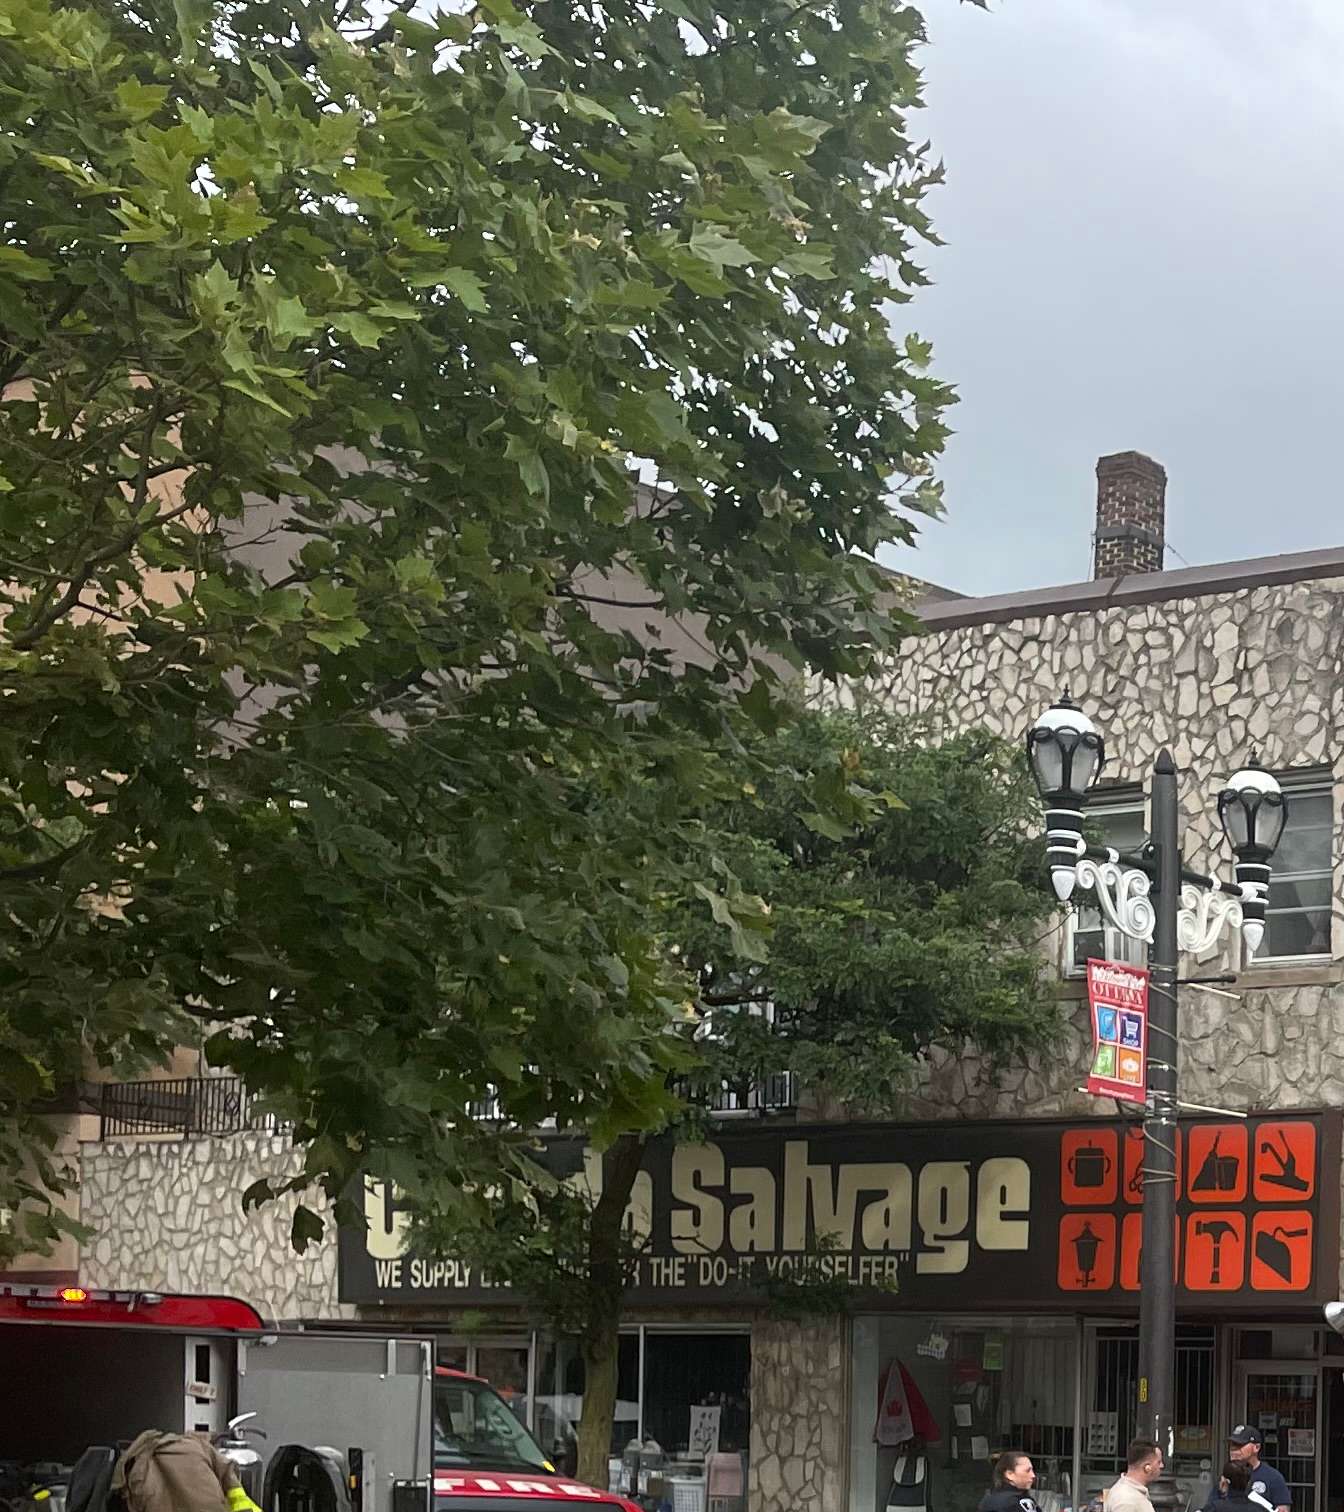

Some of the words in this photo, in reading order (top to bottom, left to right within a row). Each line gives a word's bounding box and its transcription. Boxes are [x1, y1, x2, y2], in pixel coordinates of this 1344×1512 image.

[671, 1141, 1031, 1275] Salvage
[375, 1260, 403, 1289] WE
[410, 1259, 471, 1289] SUPPLY
[433, 1477, 601, 1499] FIRE
